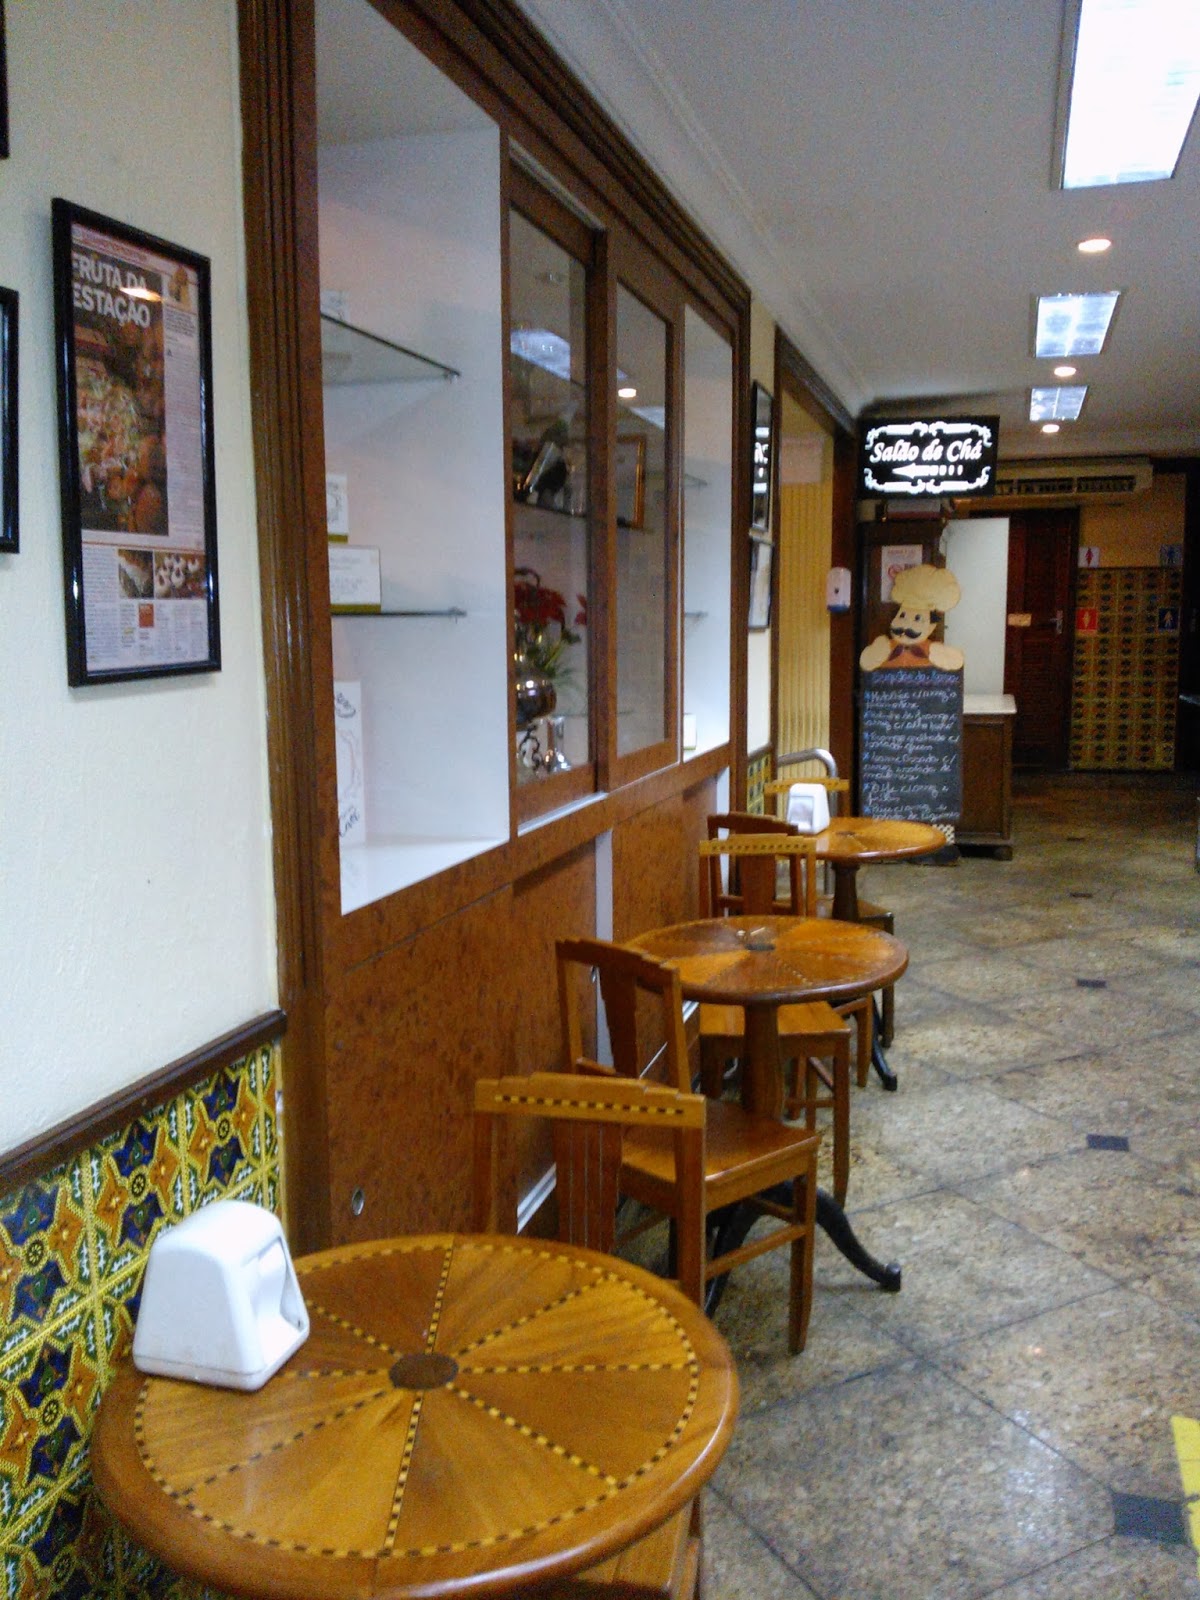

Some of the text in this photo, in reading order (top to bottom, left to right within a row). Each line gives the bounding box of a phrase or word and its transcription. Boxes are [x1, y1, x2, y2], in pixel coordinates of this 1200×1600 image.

[869, 438, 983, 463] Salão de Chá
